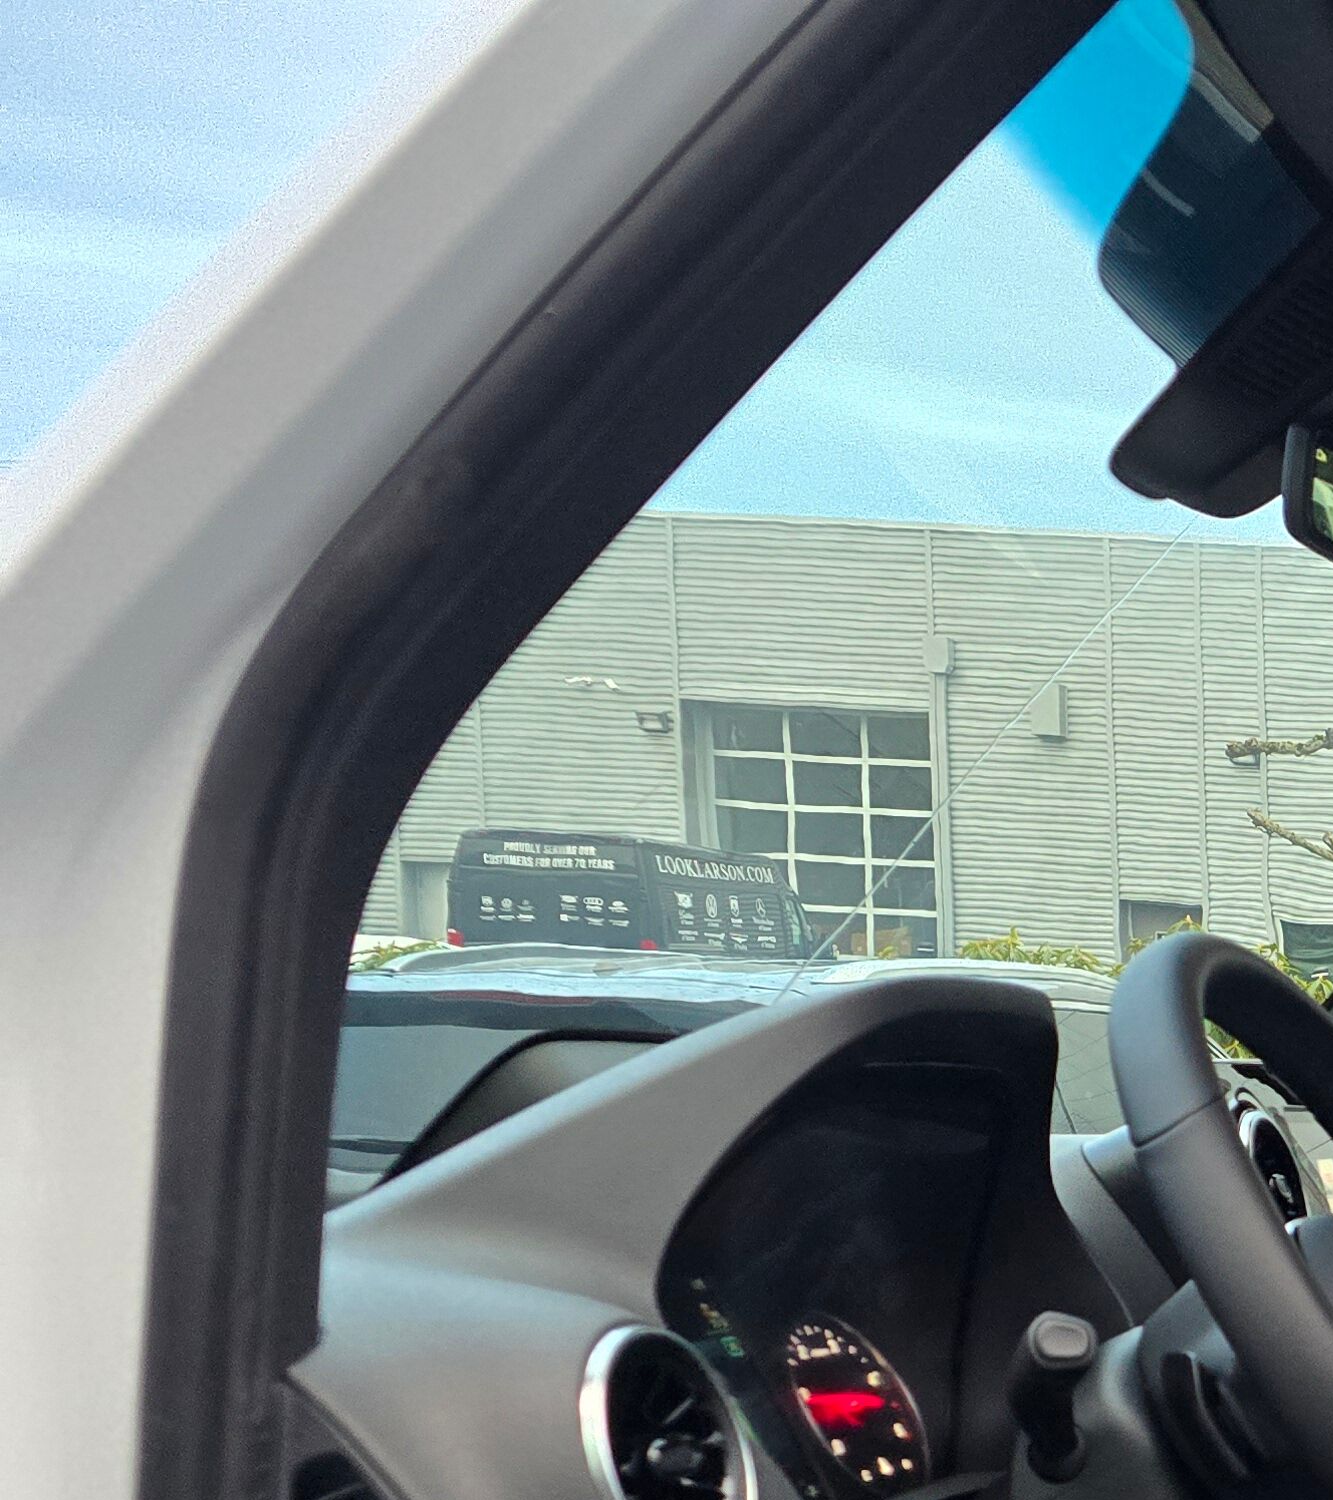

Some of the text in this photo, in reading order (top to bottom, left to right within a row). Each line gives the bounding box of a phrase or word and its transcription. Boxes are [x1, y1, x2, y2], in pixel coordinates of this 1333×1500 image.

[503, 842, 541, 854] PROUDLY
[578, 846, 597, 856] OUR
[483, 853, 534, 867] CUSTOMERS
[535, 857, 551, 868] FOR
[551, 857, 573, 868] OVER
[587, 859, 615, 870] YEARS
[654, 854, 775, 884] LOOKLARSON.COM
